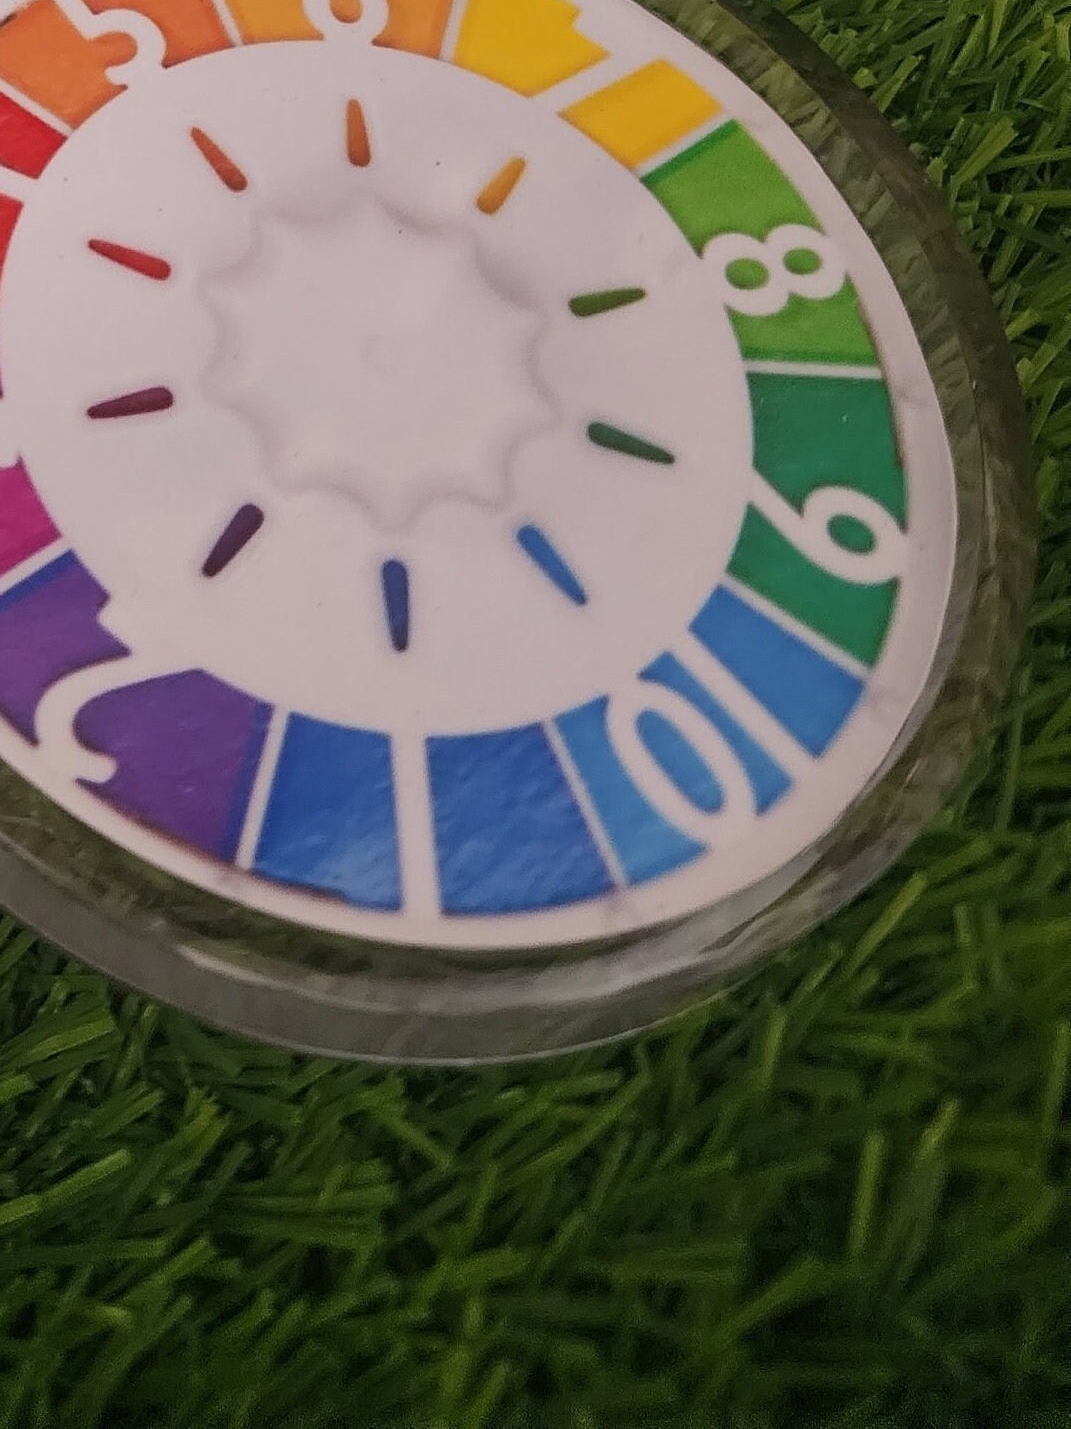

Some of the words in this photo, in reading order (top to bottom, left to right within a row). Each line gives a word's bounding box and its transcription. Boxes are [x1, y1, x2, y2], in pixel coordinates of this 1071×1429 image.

[528, 2, 662, 114] 7
[700, 224, 847, 317] 8
[748, 468, 911, 585] 9
[34, 594, 202, 785] 2
[605, 628, 818, 852] 10
